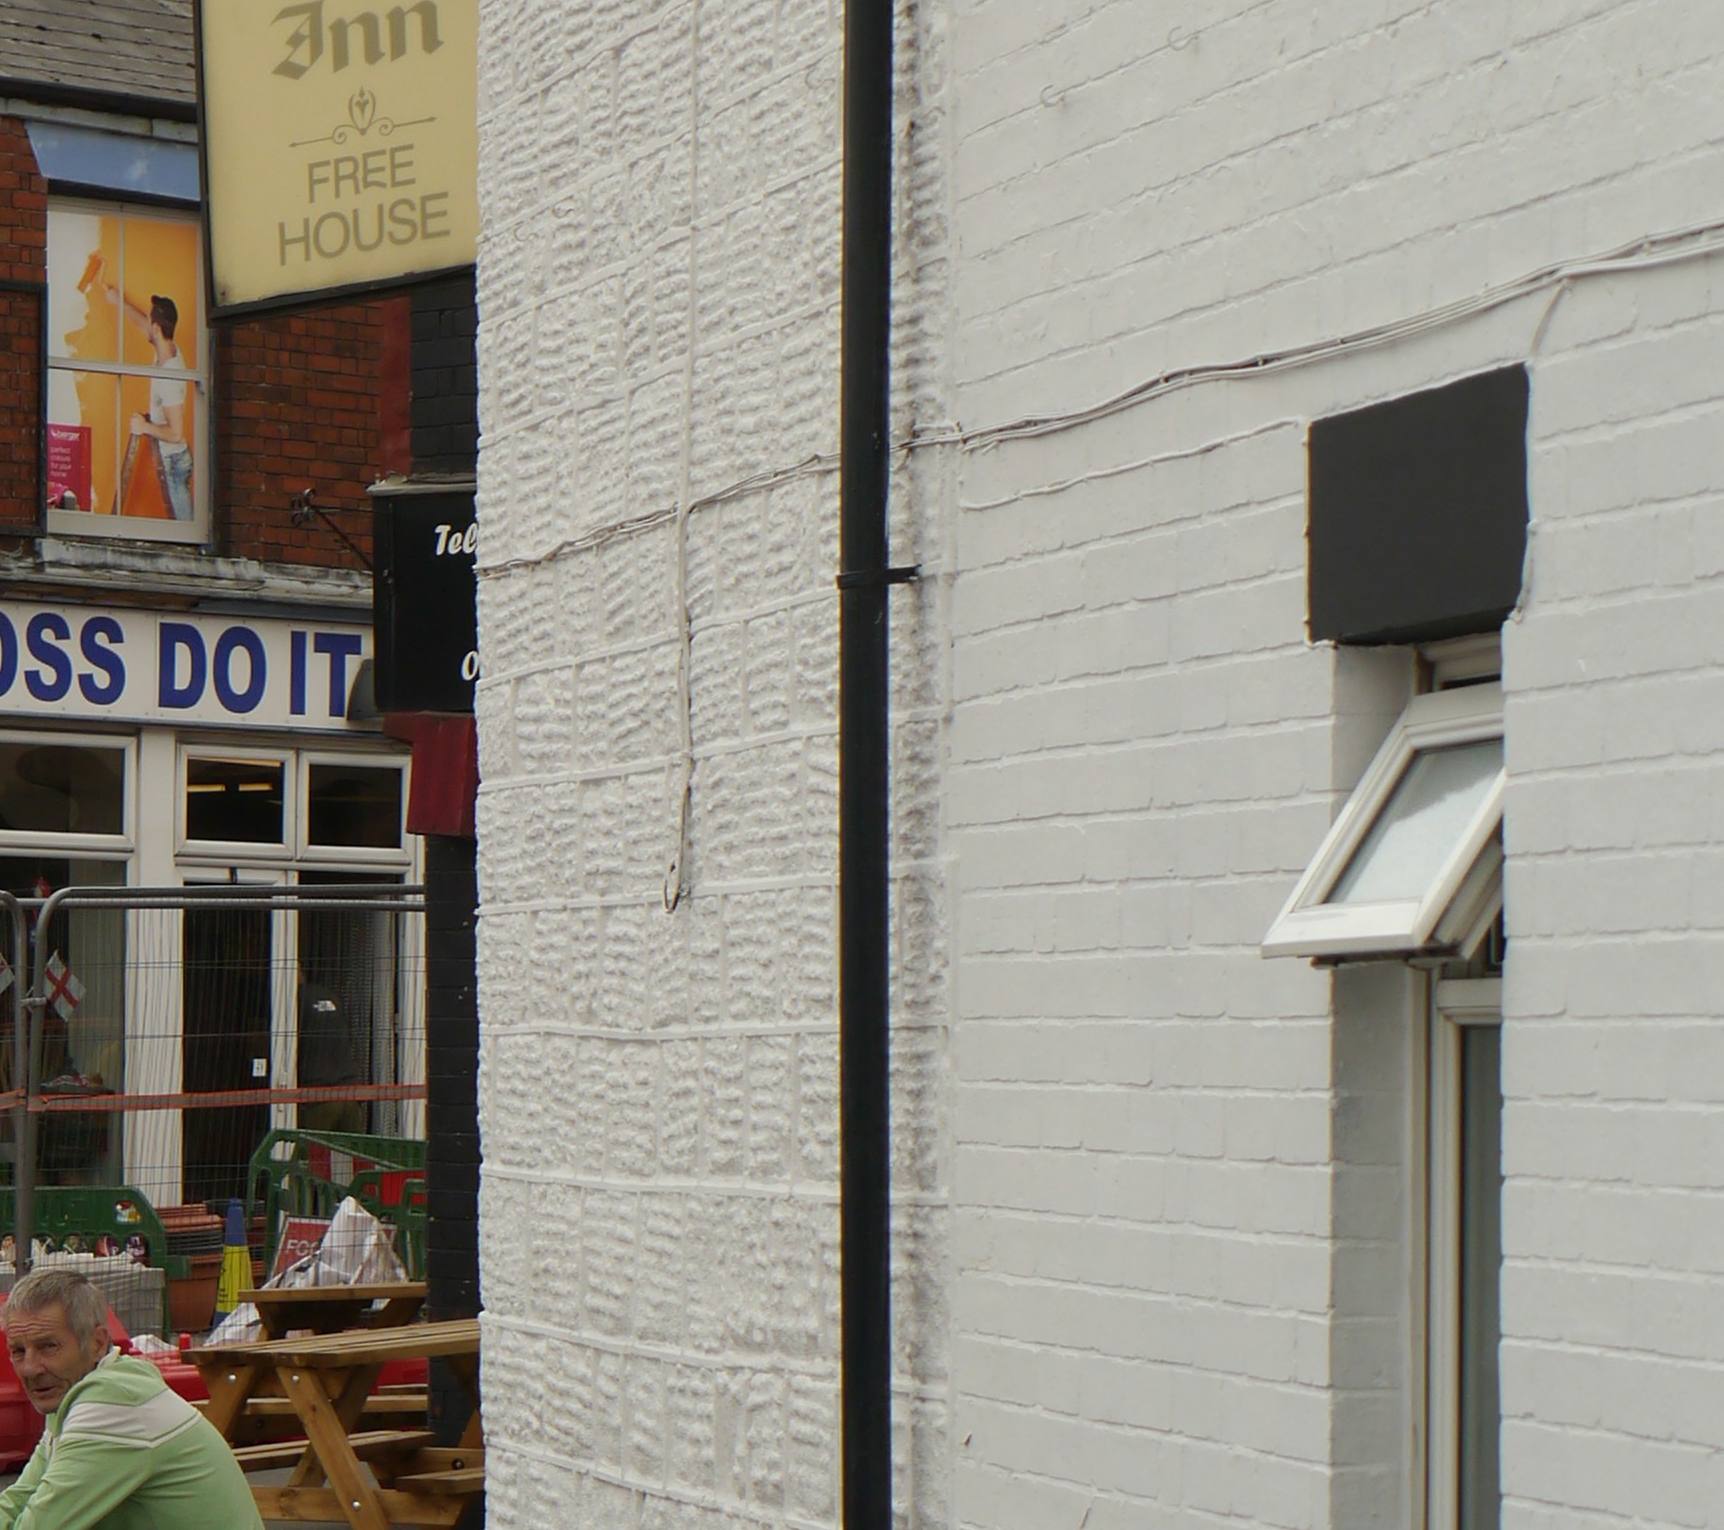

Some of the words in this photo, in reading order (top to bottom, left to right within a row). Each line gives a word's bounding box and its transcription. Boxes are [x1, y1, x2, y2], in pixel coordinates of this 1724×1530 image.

[269, 0, 444, 81] Inn
[308, 143, 416, 204] FREE
[278, 191, 451, 266] HOUSE
[158, 621, 267, 715] DO
[289, 630, 363, 718] IT
